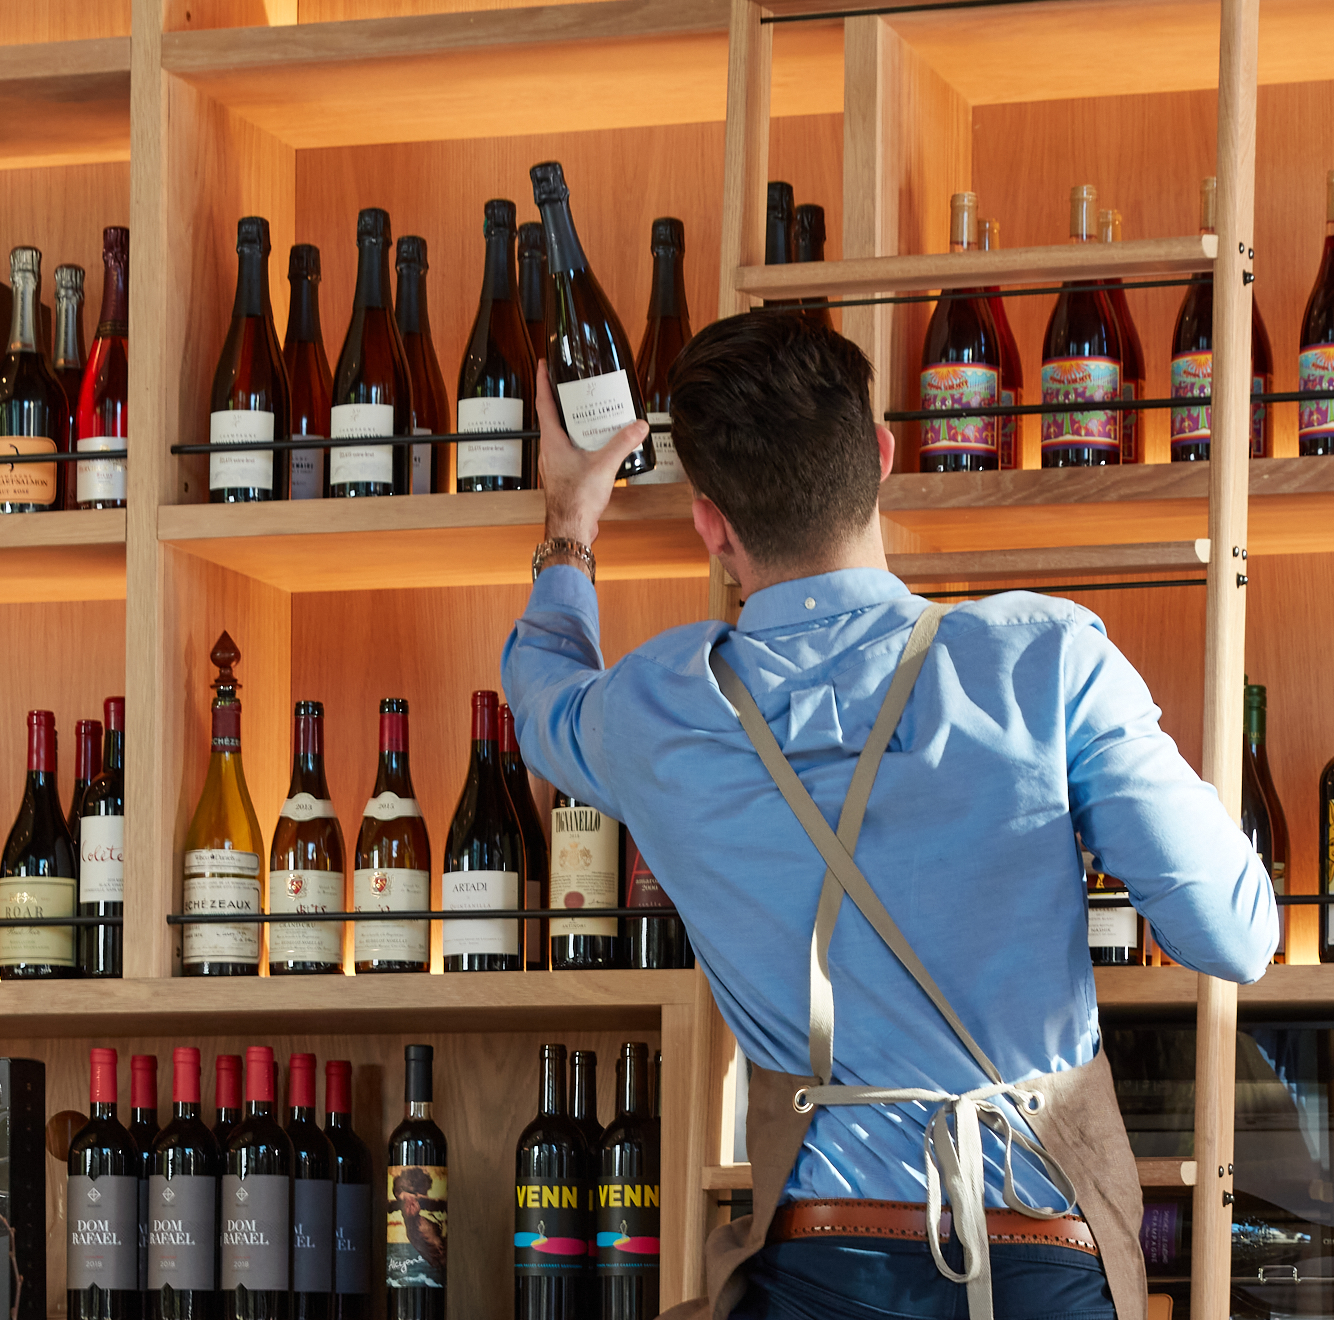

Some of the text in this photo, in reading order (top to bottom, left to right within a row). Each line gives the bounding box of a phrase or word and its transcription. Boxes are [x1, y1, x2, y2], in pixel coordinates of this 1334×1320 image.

[452, 881, 488, 893] ARTADI
[5, 905, 44, 919] ROAR
[516, 1185, 578, 1209] VENN
[598, 1184, 660, 1208] VENN
[77, 1219, 109, 1232] DOM
[153, 1219, 183, 1232] DOM
[227, 1219, 257, 1232] DOM
